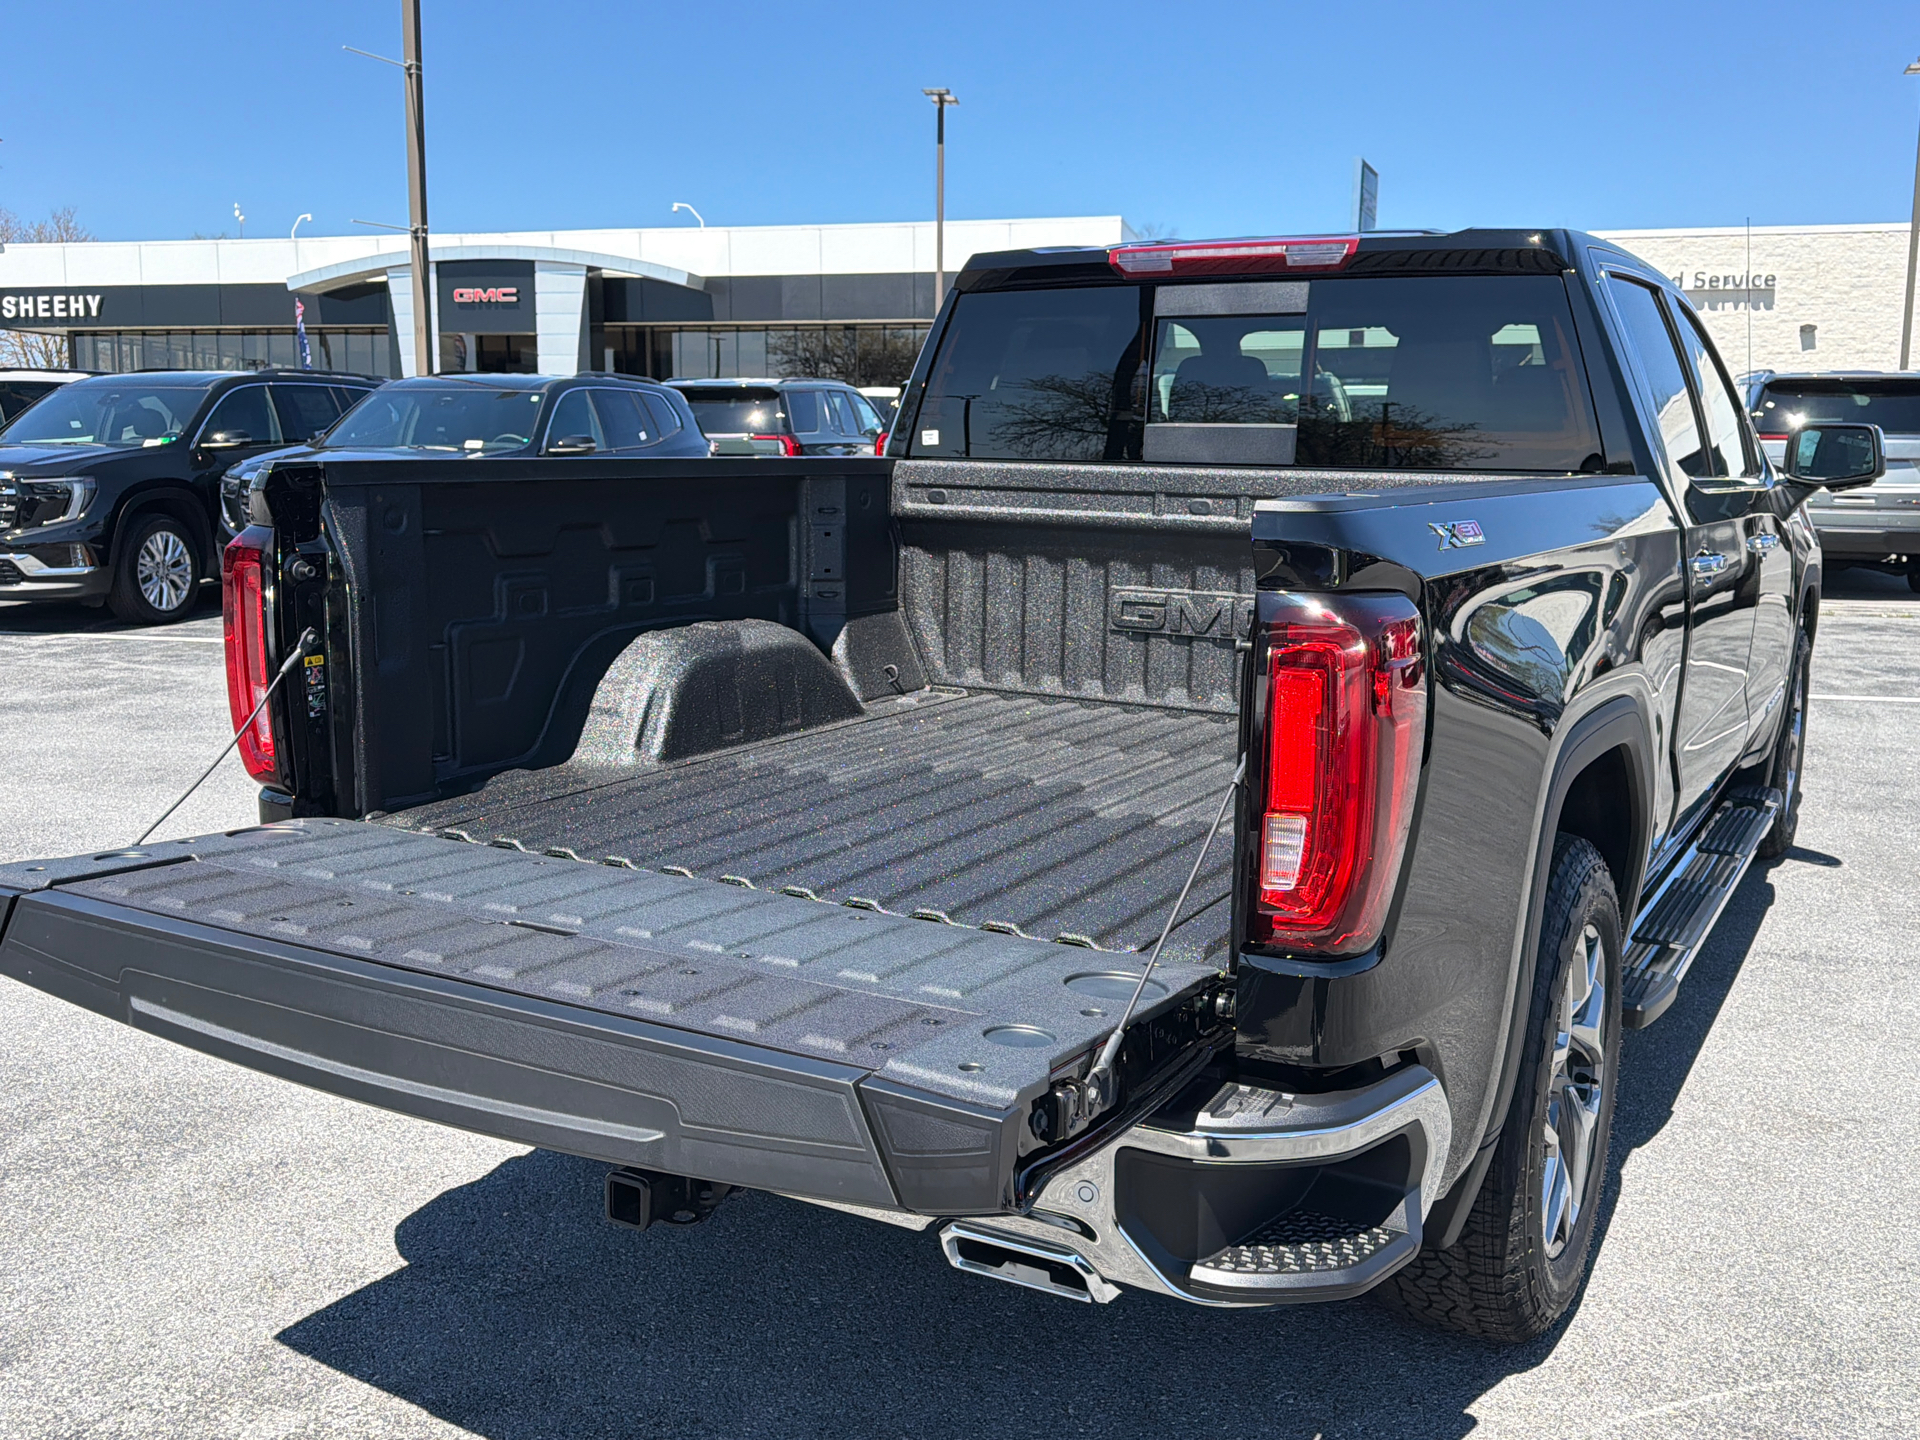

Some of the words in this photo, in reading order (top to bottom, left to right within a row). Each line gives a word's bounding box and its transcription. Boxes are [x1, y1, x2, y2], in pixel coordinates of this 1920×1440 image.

[1693, 270, 1777, 290] Service
[453, 287, 518, 303] GMC
[2, 294, 101, 319] SHEEHY
